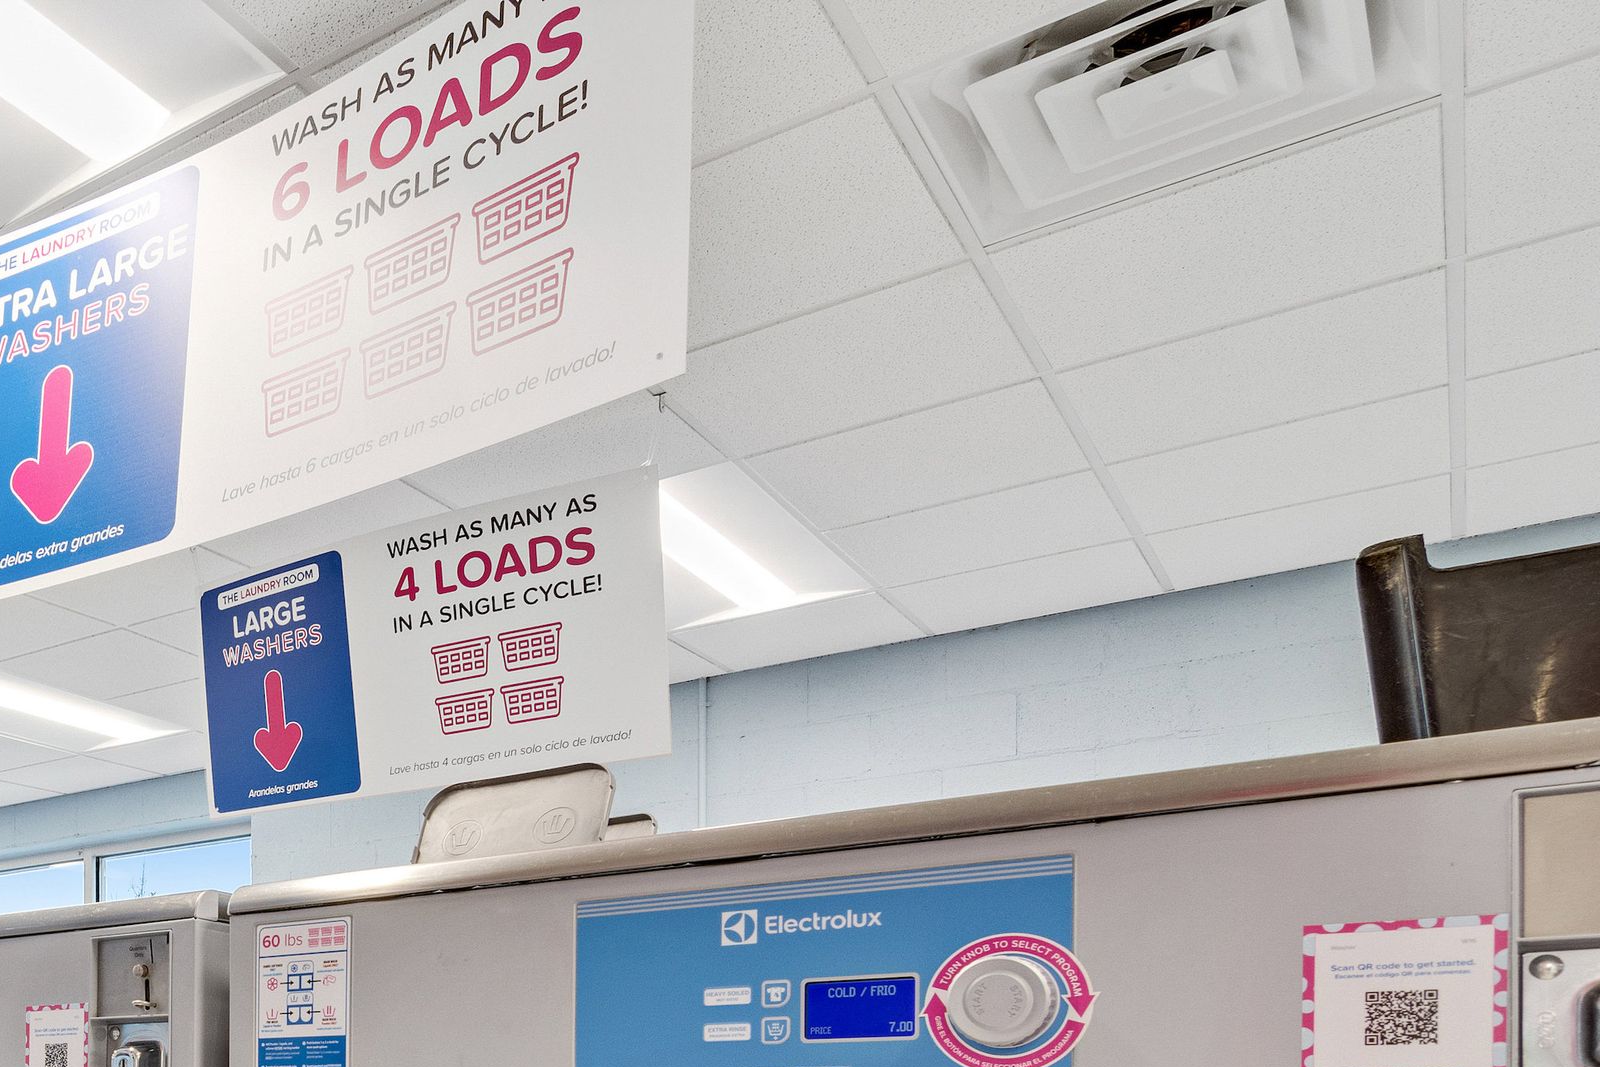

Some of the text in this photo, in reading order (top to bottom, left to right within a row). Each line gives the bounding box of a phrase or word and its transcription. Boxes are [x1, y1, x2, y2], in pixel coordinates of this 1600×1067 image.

[272, 0, 522, 156] WASH AS MANY
[272, 6, 583, 221] 6 LOADS
[263, 80, 587, 272] IN A SINGLE CYCLE!
[21, 225, 97, 265] LAUNDRY
[100, 202, 151, 234] ROOM
[69, 223, 189, 300] LARGE
[221, 341, 617, 503] Lave hasta 6 cargas en un solo ciclo de lavado!
[36, 541, 68, 559] extra
[71, 524, 124, 552] grandes
[387, 494, 597, 558] WASH AS MANY AS
[223, 569, 313, 605] THE LAUNDRY ROOM
[395, 527, 596, 601] 4 LOADS
[233, 596, 306, 638] LARGE
[393, 574, 602, 633] IN A SINGLE CYCLE!
[223, 624, 322, 667] WASHERS
[389, 730, 632, 776] Lave hasta 4 cargas en un solo ciclo de lavado!
[248, 779, 318, 798] Arandelas grandes
[263, 933, 303, 948] 60 lbs
[765, 910, 882, 934] Electrolux
[939, 940, 1082, 997] TURN KNOB TO SELECT PROGRAM
[1331, 964, 1355, 972] Scan
[1358, 963, 1373, 971] QR
[1376, 962, 1400, 970] code
[1417, 961, 1433, 969] get
[1437, 959, 1476, 967] started.
[828, 985, 896, 998] COLD / FRIO
[810, 1021, 913, 1035] PRICE 7.00
[934, 1016, 944, 1032] GIRE
[939, 1028, 947, 1039] EL
[944, 1038, 964, 1058] BOTÓN
[963, 1054, 980, 1066] PARA
[1033, 1057, 1042, 1065] EL
[1043, 1029, 1074, 1060] PROGRAMA
